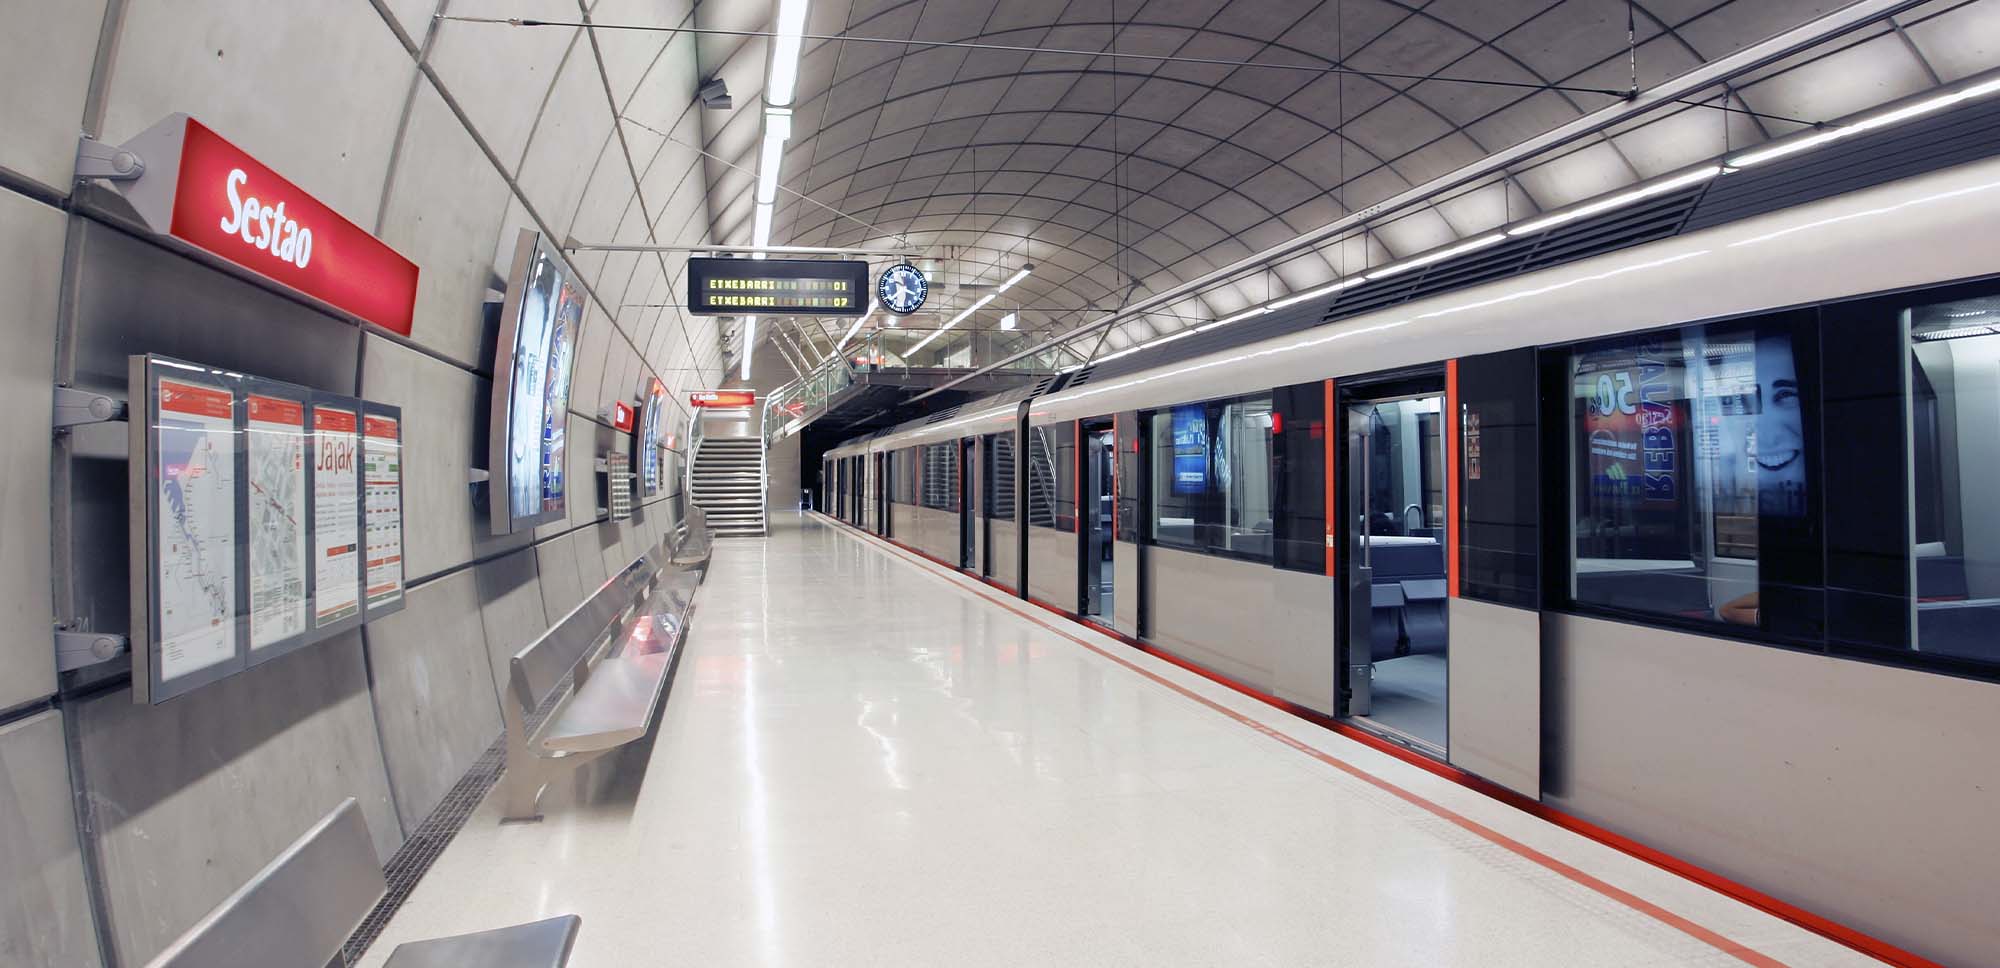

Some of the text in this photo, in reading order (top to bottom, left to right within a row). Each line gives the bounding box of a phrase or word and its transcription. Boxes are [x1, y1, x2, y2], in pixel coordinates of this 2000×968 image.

[220, 168, 312, 269] Sestao
[709, 279, 847, 290] ETXEBARRI 01
[709, 296, 848, 307] ETXEBARRI 07
